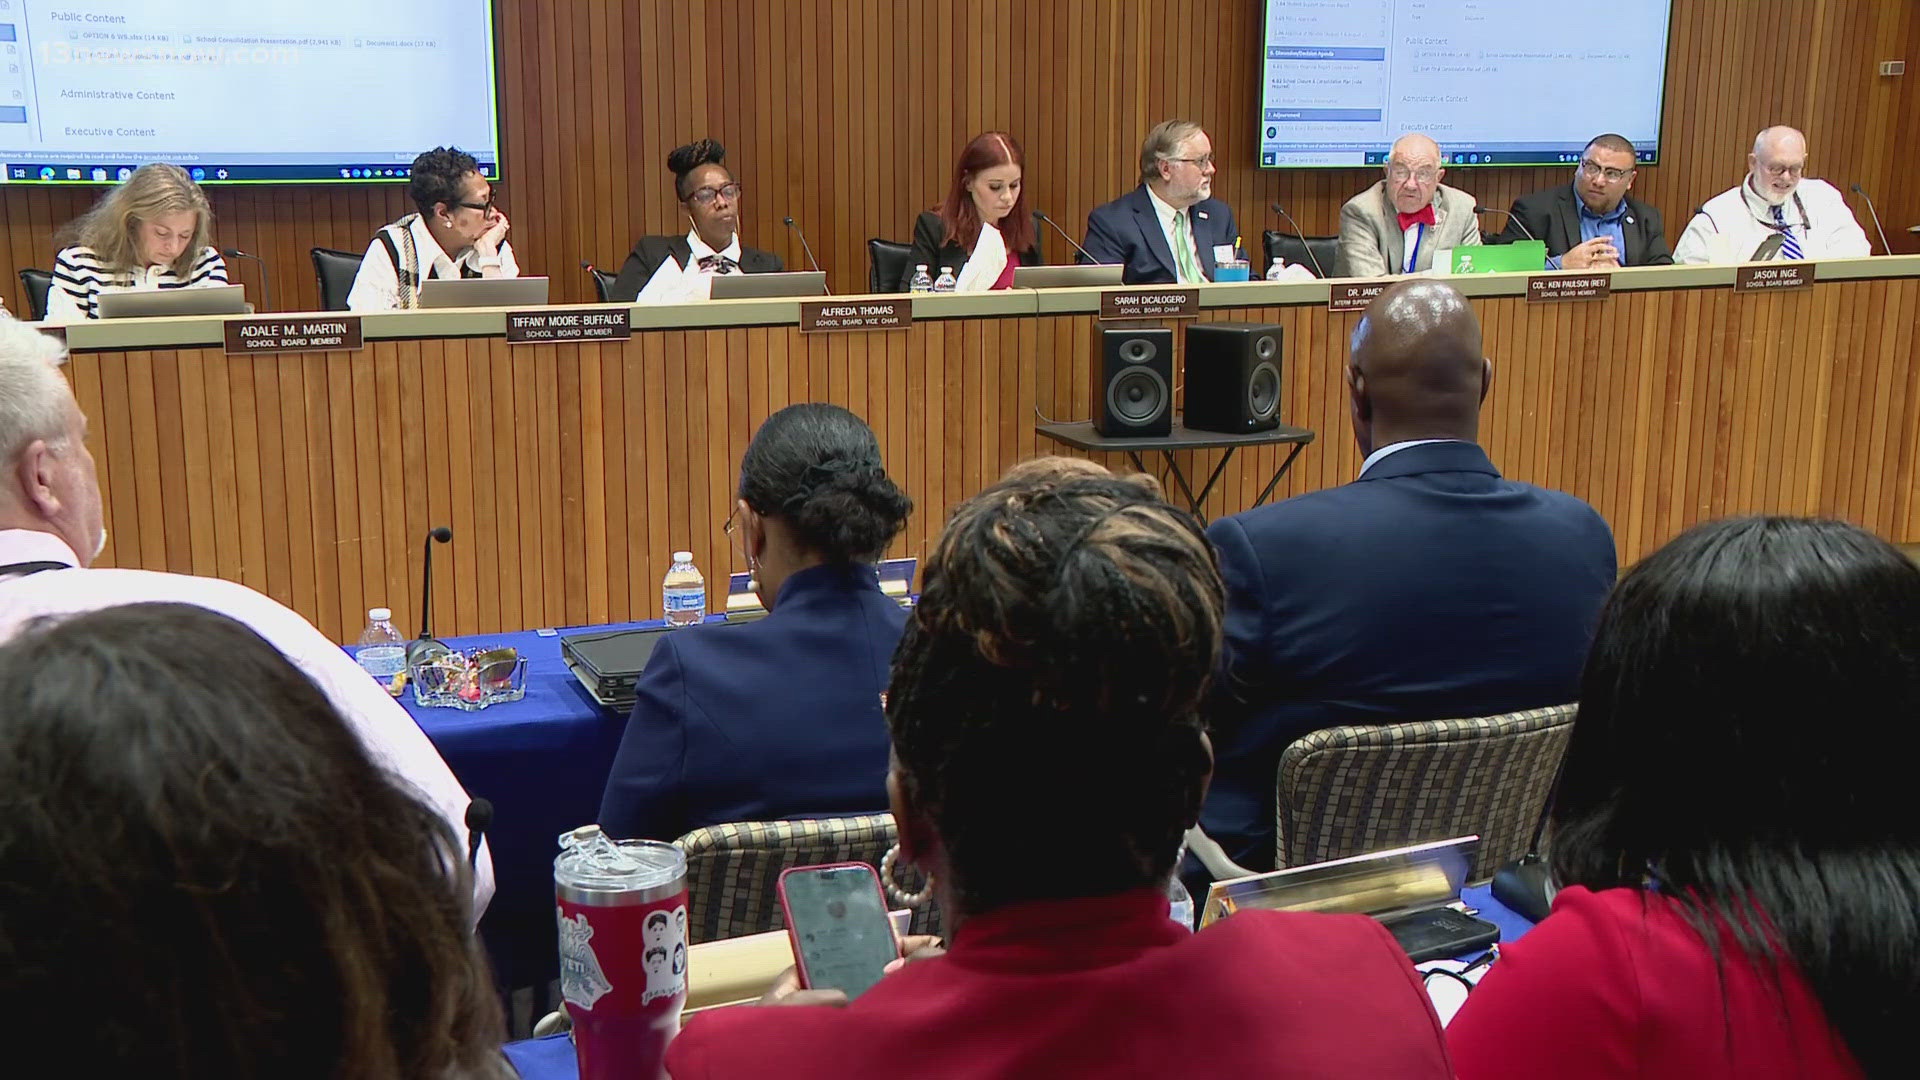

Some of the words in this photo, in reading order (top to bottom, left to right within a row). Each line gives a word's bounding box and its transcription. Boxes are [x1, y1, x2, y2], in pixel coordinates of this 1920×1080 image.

[51, 12, 82, 22] Public
[85, 13, 126, 24] Content
[82, 32, 109, 40] OPTION
[1406, 37, 1423, 45] Public
[60, 89, 134, 99] Administrative
[136, 91, 176, 100] Content
[64, 127, 113, 136] Executive
[116, 128, 156, 136] Content
[1400, 123, 1428, 131] Executive
[1430, 123, 1453, 131] Content
[1753, 270, 1778, 280] JASON
[1780, 269, 1798, 278] INGE
[1548, 280, 1561, 288] KEN
[1562, 280, 1589, 288] PAULSON
[1590, 279, 1606, 288] (RET)
[1348, 288, 1360, 297] DR.
[1362, 288, 1383, 296] JAMES
[1114, 296, 1139, 305] SARAH
[821, 306, 857, 317] ALFREDA
[860, 306, 894, 315] THOMAS
[512, 317, 546, 327] TIFFANY
[548, 314, 625, 327] MOORE-BUFFALOE
[816, 319, 840, 327] SCHOOL
[881, 317, 899, 325] CHAIR
[240, 325, 279, 337] ADALE
[284, 325, 299, 336] M.
[303, 323, 347, 335] MARTIN
[526, 330, 554, 338] SCHOOL
[557, 329, 581, 337] BOARD
[584, 328, 612, 336] MEMBER
[246, 339, 278, 348] SCHOOL
[281, 338, 307, 347] BOARD
[310, 337, 342, 346] MEMBER
